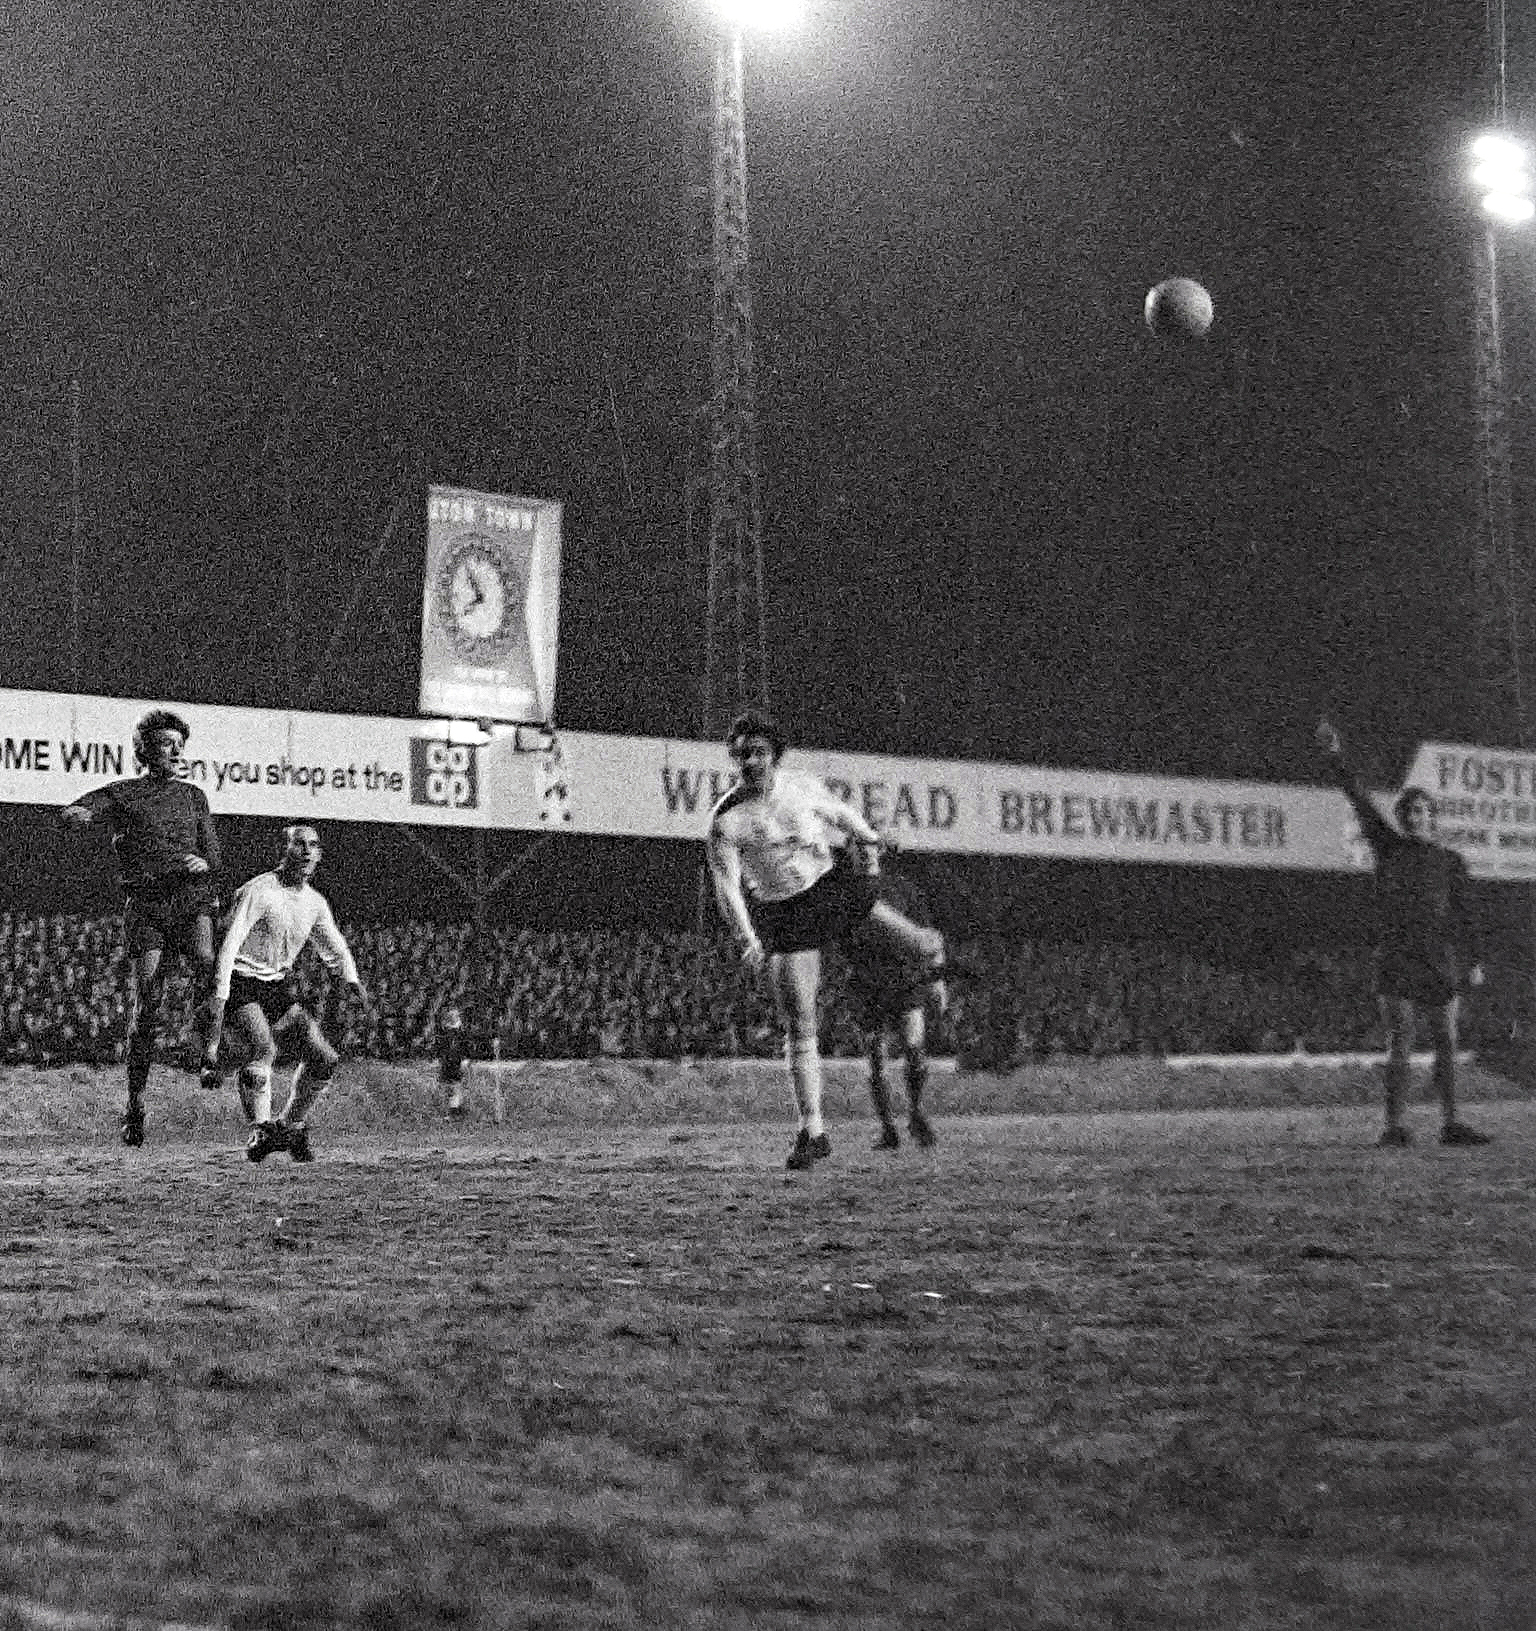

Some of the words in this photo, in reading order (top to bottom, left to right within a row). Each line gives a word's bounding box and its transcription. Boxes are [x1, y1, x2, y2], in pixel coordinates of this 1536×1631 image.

[60, 739, 123, 776] WIN
[212, 758, 260, 791] you
[266, 753, 327, 796] shop
[331, 762, 359, 790] at
[364, 761, 404, 791] the
[1437, 754, 1536, 796] FOST
[999, 789, 1287, 848] BREWMASTER
